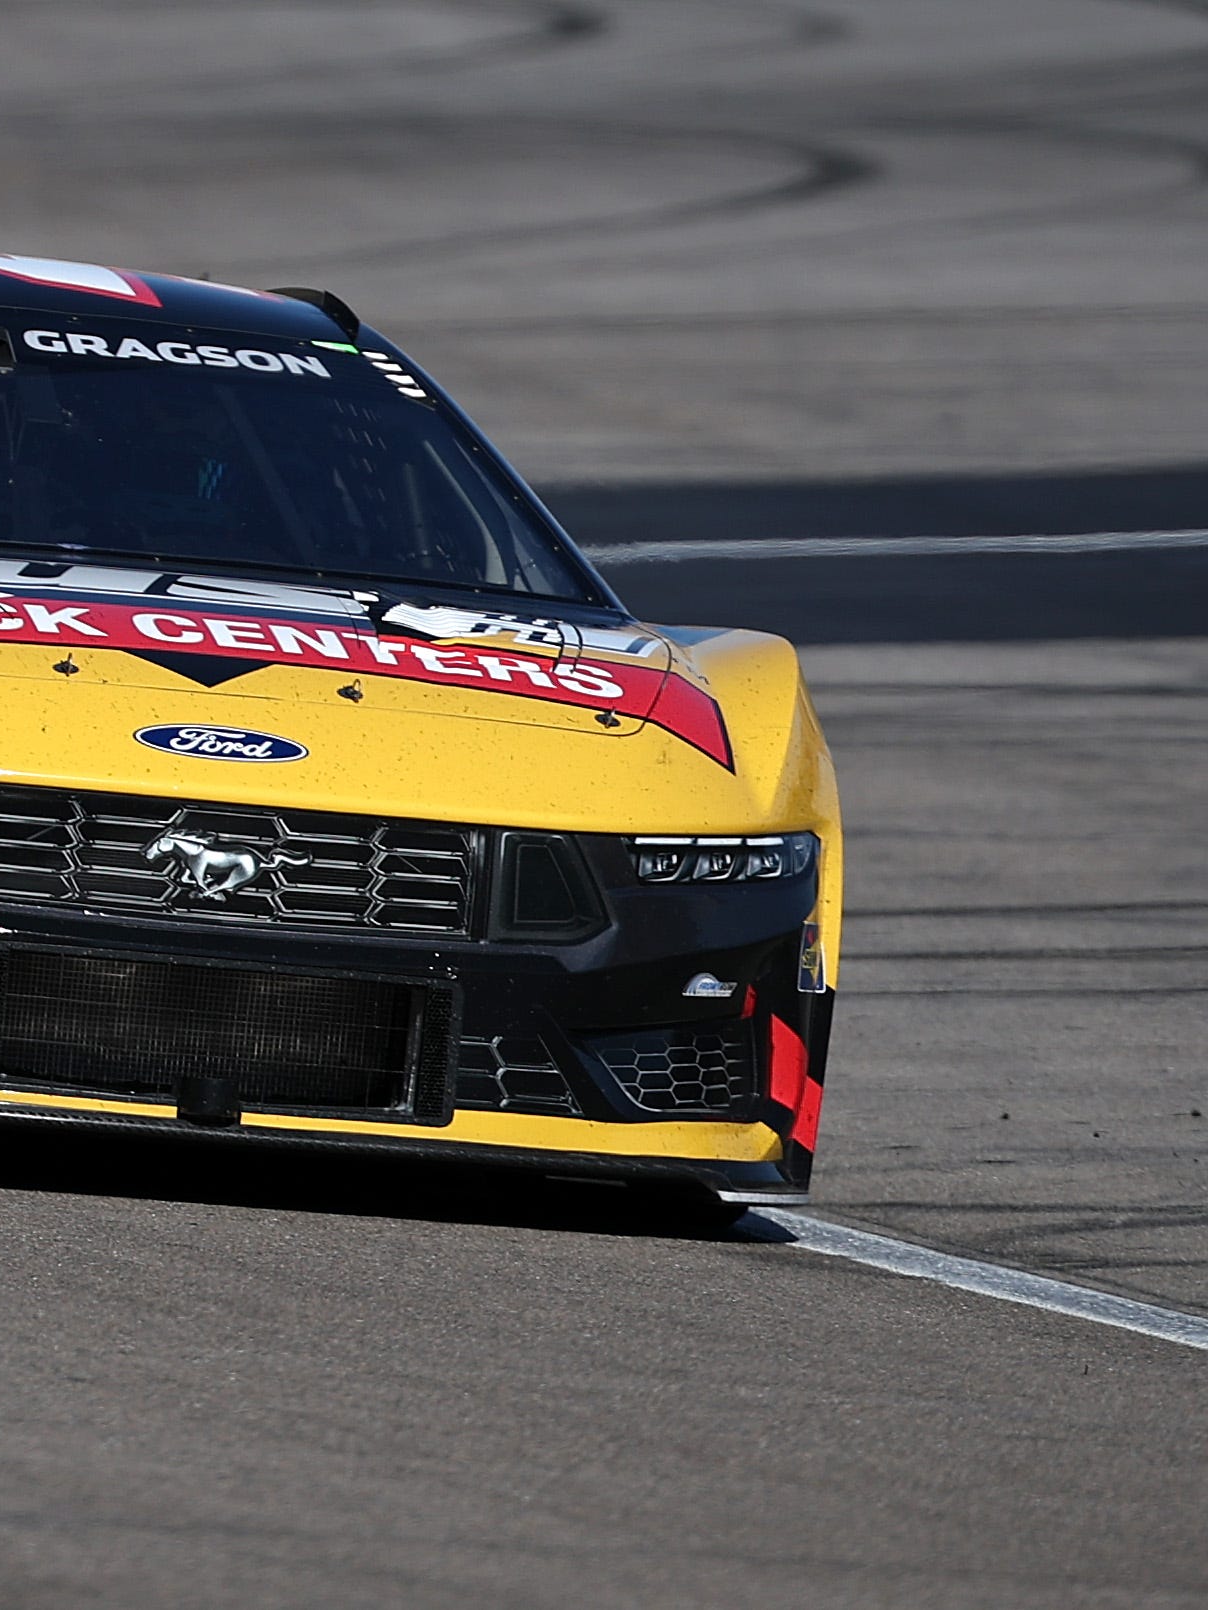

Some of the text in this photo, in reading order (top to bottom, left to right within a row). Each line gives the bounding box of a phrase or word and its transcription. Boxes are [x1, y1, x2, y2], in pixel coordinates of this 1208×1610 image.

[22, 329, 332, 378] GRAGSON
[131, 612, 626, 699] CENTERS
[168, 726, 273, 759] Ford
